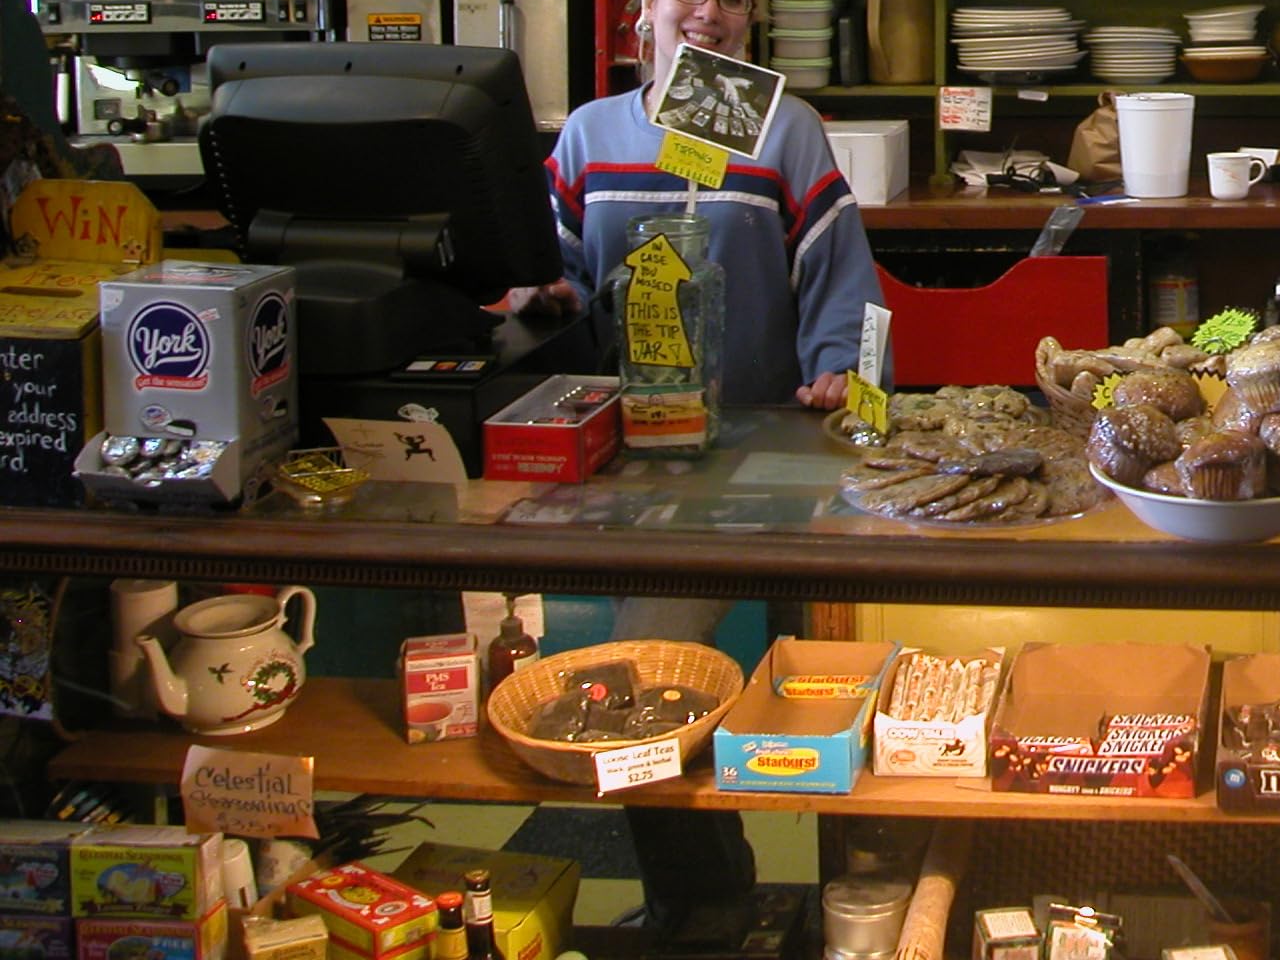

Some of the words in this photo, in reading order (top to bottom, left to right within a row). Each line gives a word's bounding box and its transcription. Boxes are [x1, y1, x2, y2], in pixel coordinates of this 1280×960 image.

[629, 303, 660, 320] THIS
[664, 306, 678, 320] IS
[254, 309, 287, 366] York
[629, 323, 652, 337] THE
[655, 324, 680, 339] TIP
[135, 323, 202, 369] York
[14, 382, 57, 403] your
[8, 403, 77, 431] address
[425, 672, 450, 683] PMS
[654, 743, 675, 755] Teas
[757, 756, 817, 769] Starburst
[1050, 757, 1146, 773] SNICKERS
